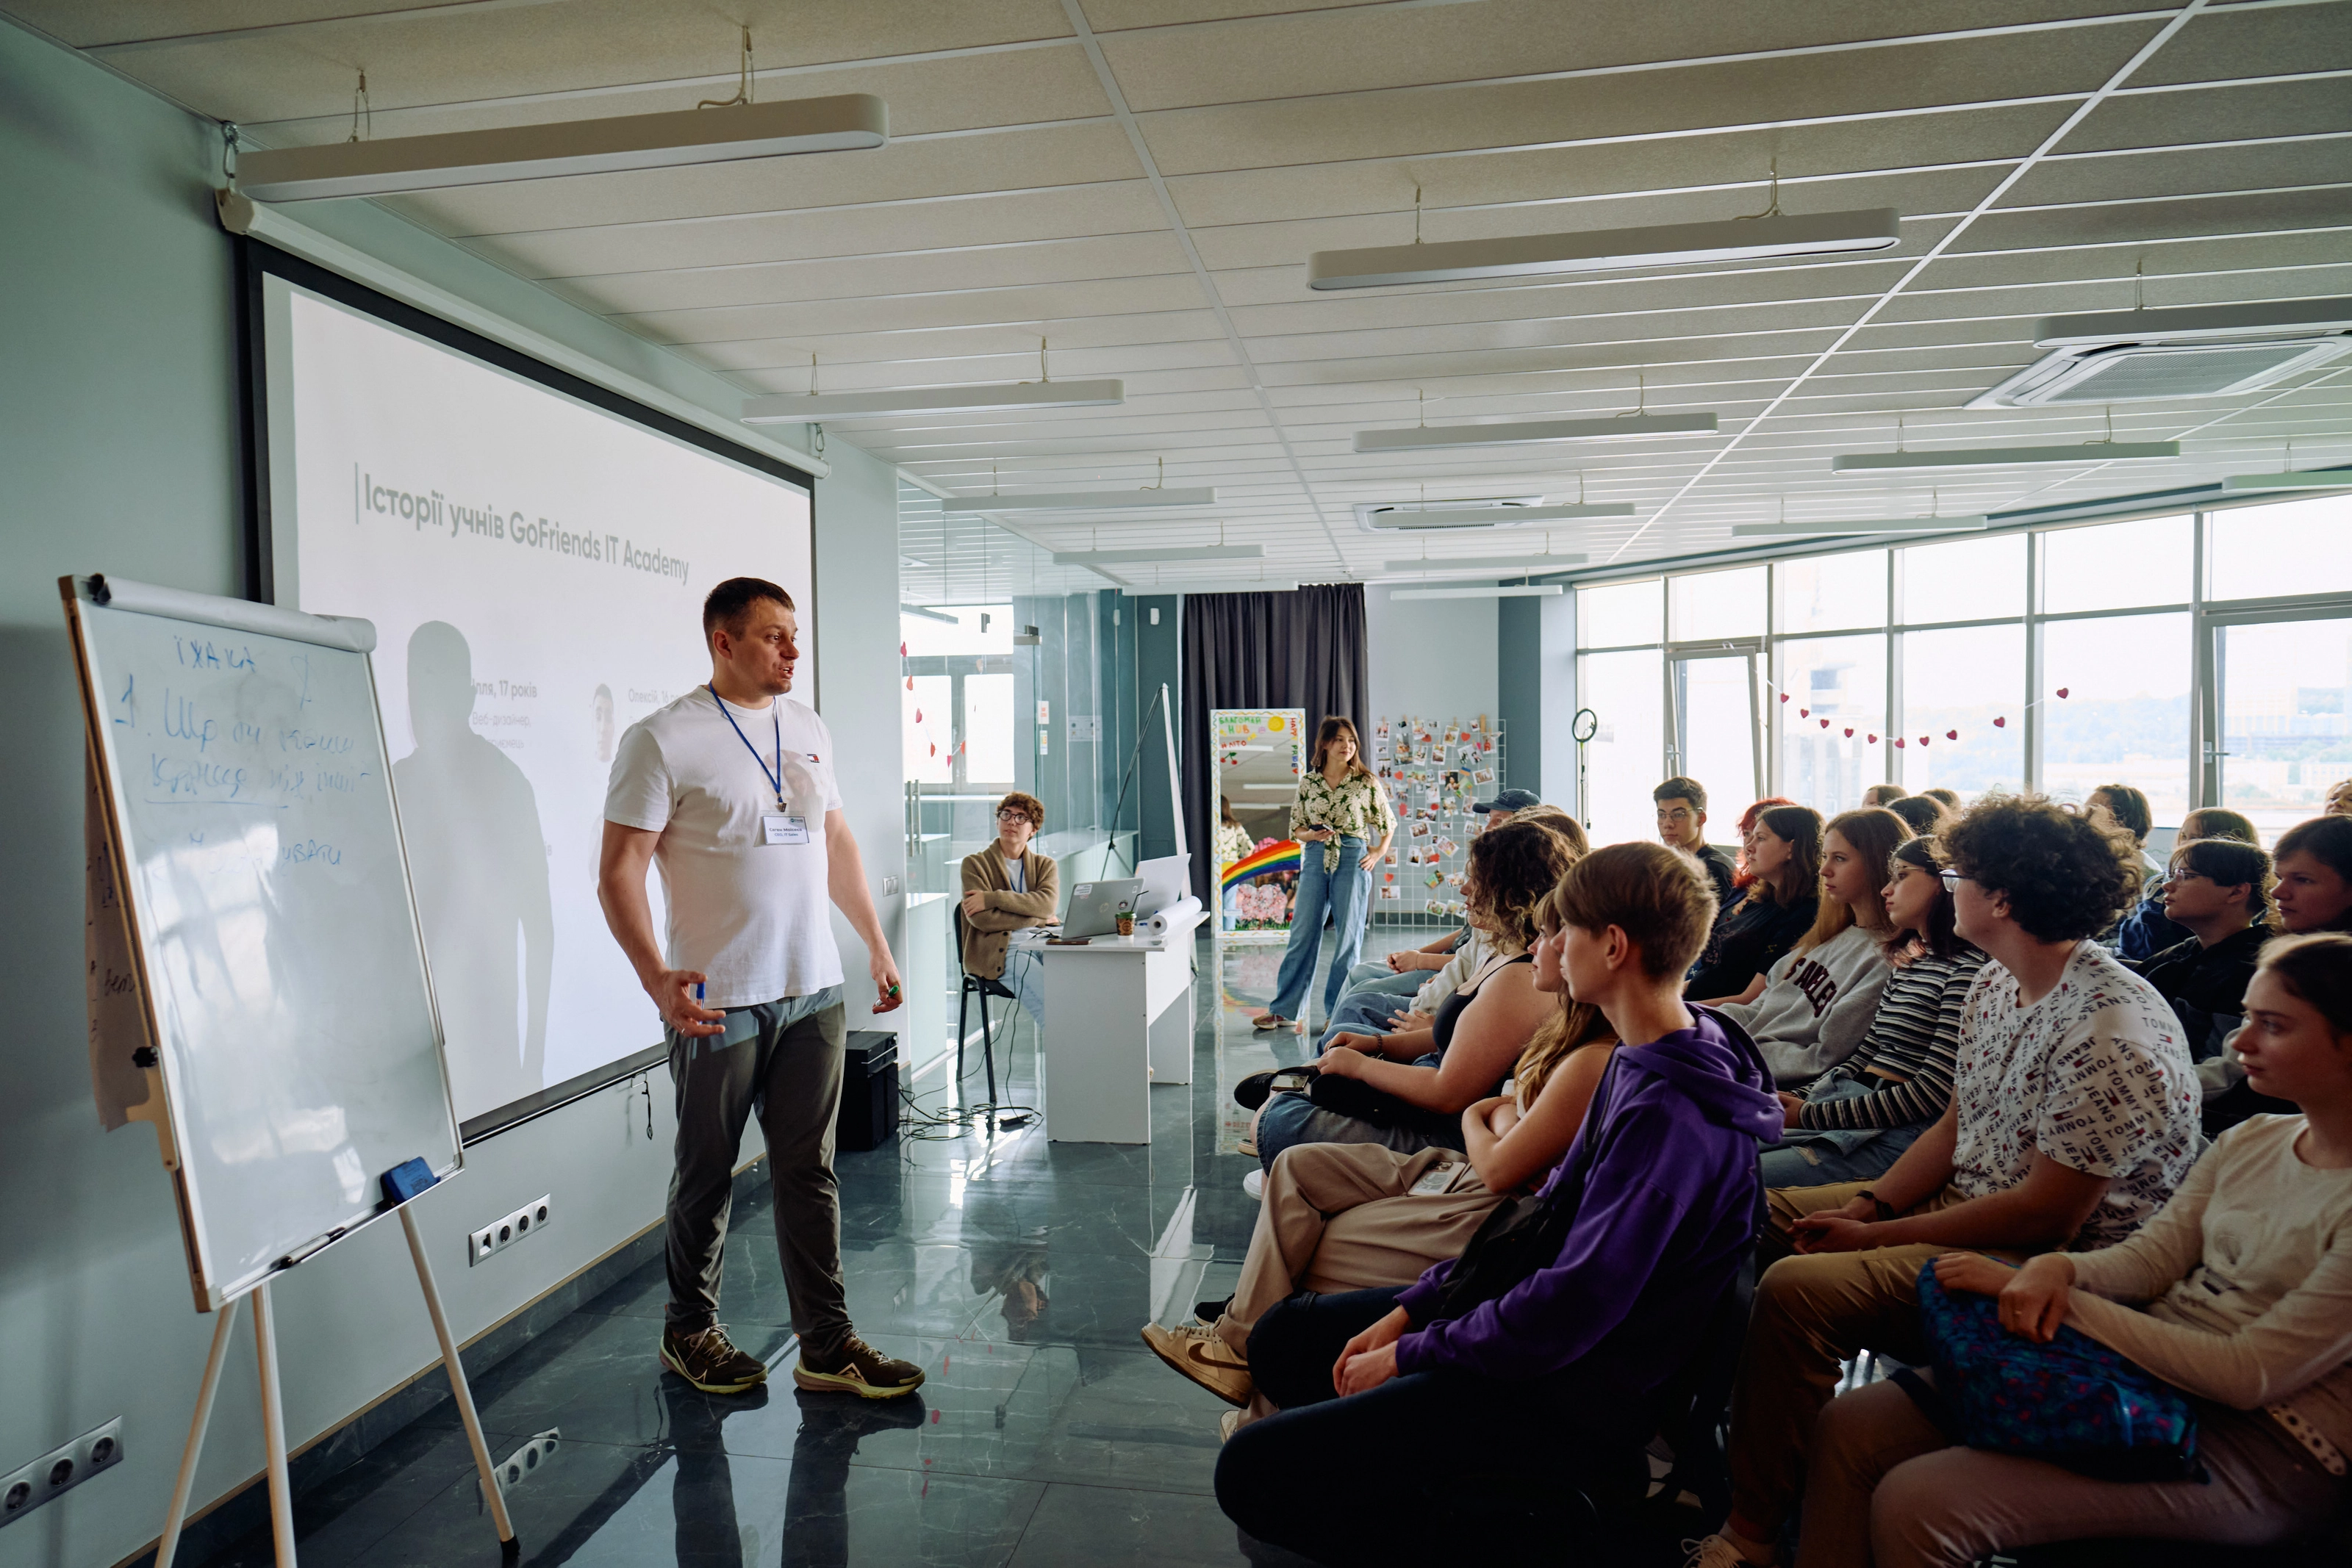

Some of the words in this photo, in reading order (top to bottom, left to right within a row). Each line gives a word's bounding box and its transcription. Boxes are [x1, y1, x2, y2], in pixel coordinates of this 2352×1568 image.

[365, 473, 443, 531] Історії
[448, 504, 504, 539] учнів
[510, 511, 601, 561] GoFriends
[605, 534, 619, 564] IT
[623, 539, 689, 586] Academy
[499, 680, 509, 697] 17
[511, 681, 537, 701] років
[628, 688, 660, 705] Олексій,
[1977, 1053, 2001, 1072] OMMY
[2057, 1036, 2096, 1067] JEANS
[2111, 1037, 2135, 1061] ANS
[2068, 1055, 2118, 1086] TOMMY
[2125, 1059, 2156, 1078] TOM
[2083, 1085, 2117, 1122] JEANS
[2107, 1068, 2142, 1111] TOMMY
[2143, 1082, 2168, 1098] JEA
[2048, 1115, 2096, 1137] TOMMY
[2104, 1110, 2154, 1138] TOMMY
[1991, 1137, 2007, 1176] TOMMY
[2016, 1134, 2037, 1154] MMY
[2061, 1140, 2090, 1172] JEAN
[2085, 1129, 2118, 1169] TOMMY
[2121, 1129, 2165, 1157] JEANS
